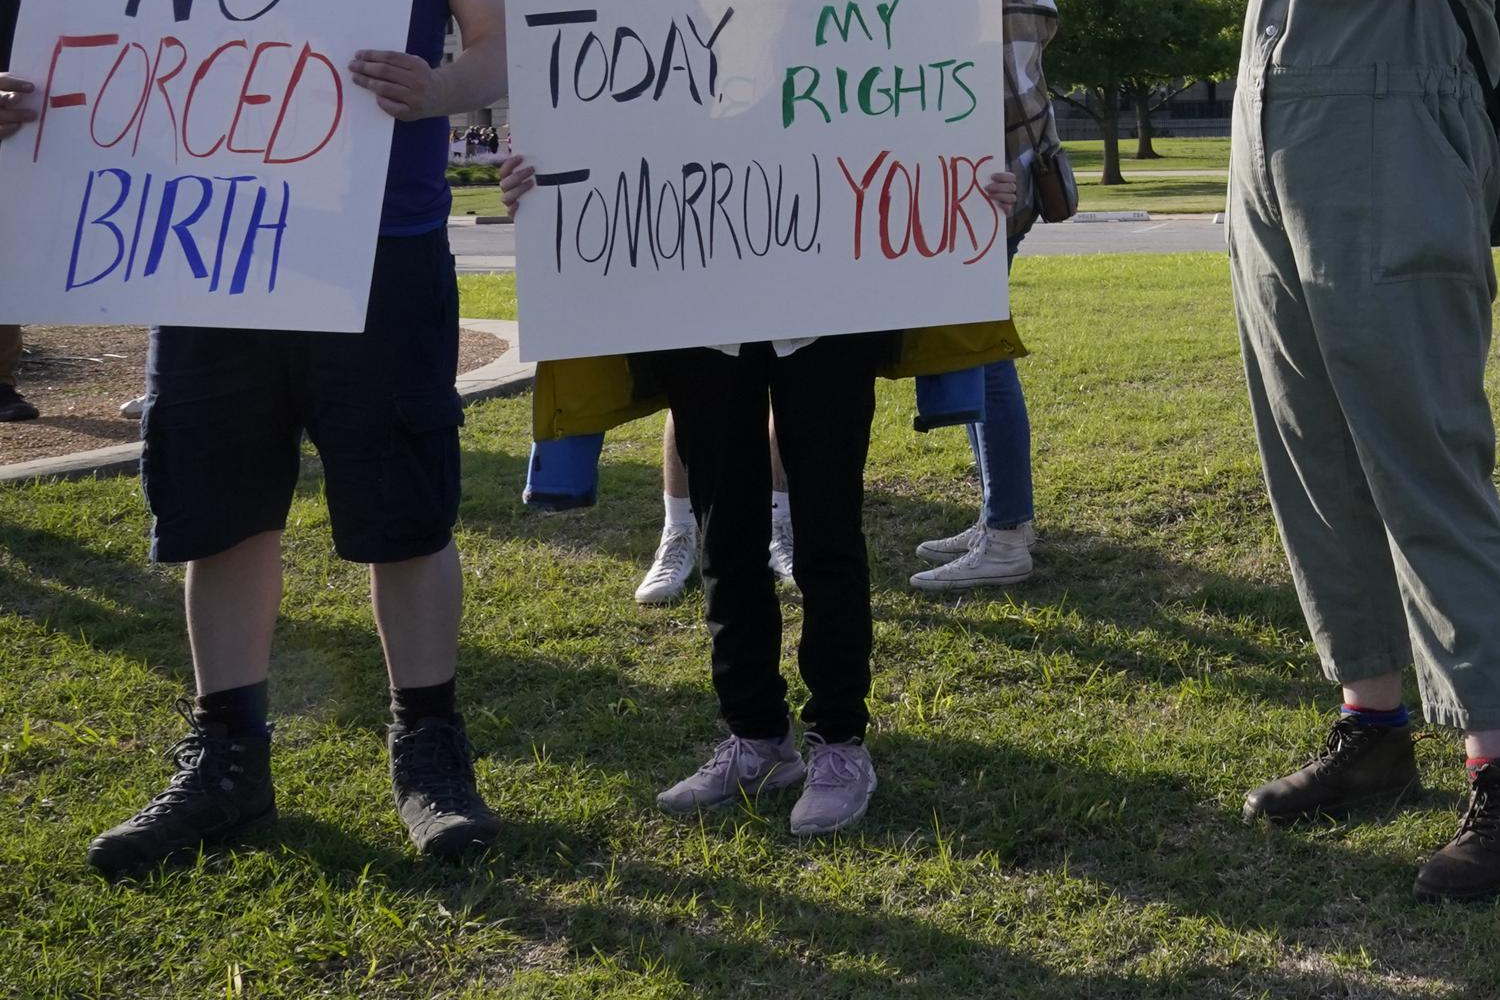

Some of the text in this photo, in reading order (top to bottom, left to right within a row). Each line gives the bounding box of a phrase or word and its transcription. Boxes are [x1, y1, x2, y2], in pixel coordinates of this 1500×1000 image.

[33, 34, 343, 164] FORCED
[782, 59, 976, 128] RIGHTS
[66, 168, 290, 295] BIRTH
[837, 150, 998, 265] YOURS
